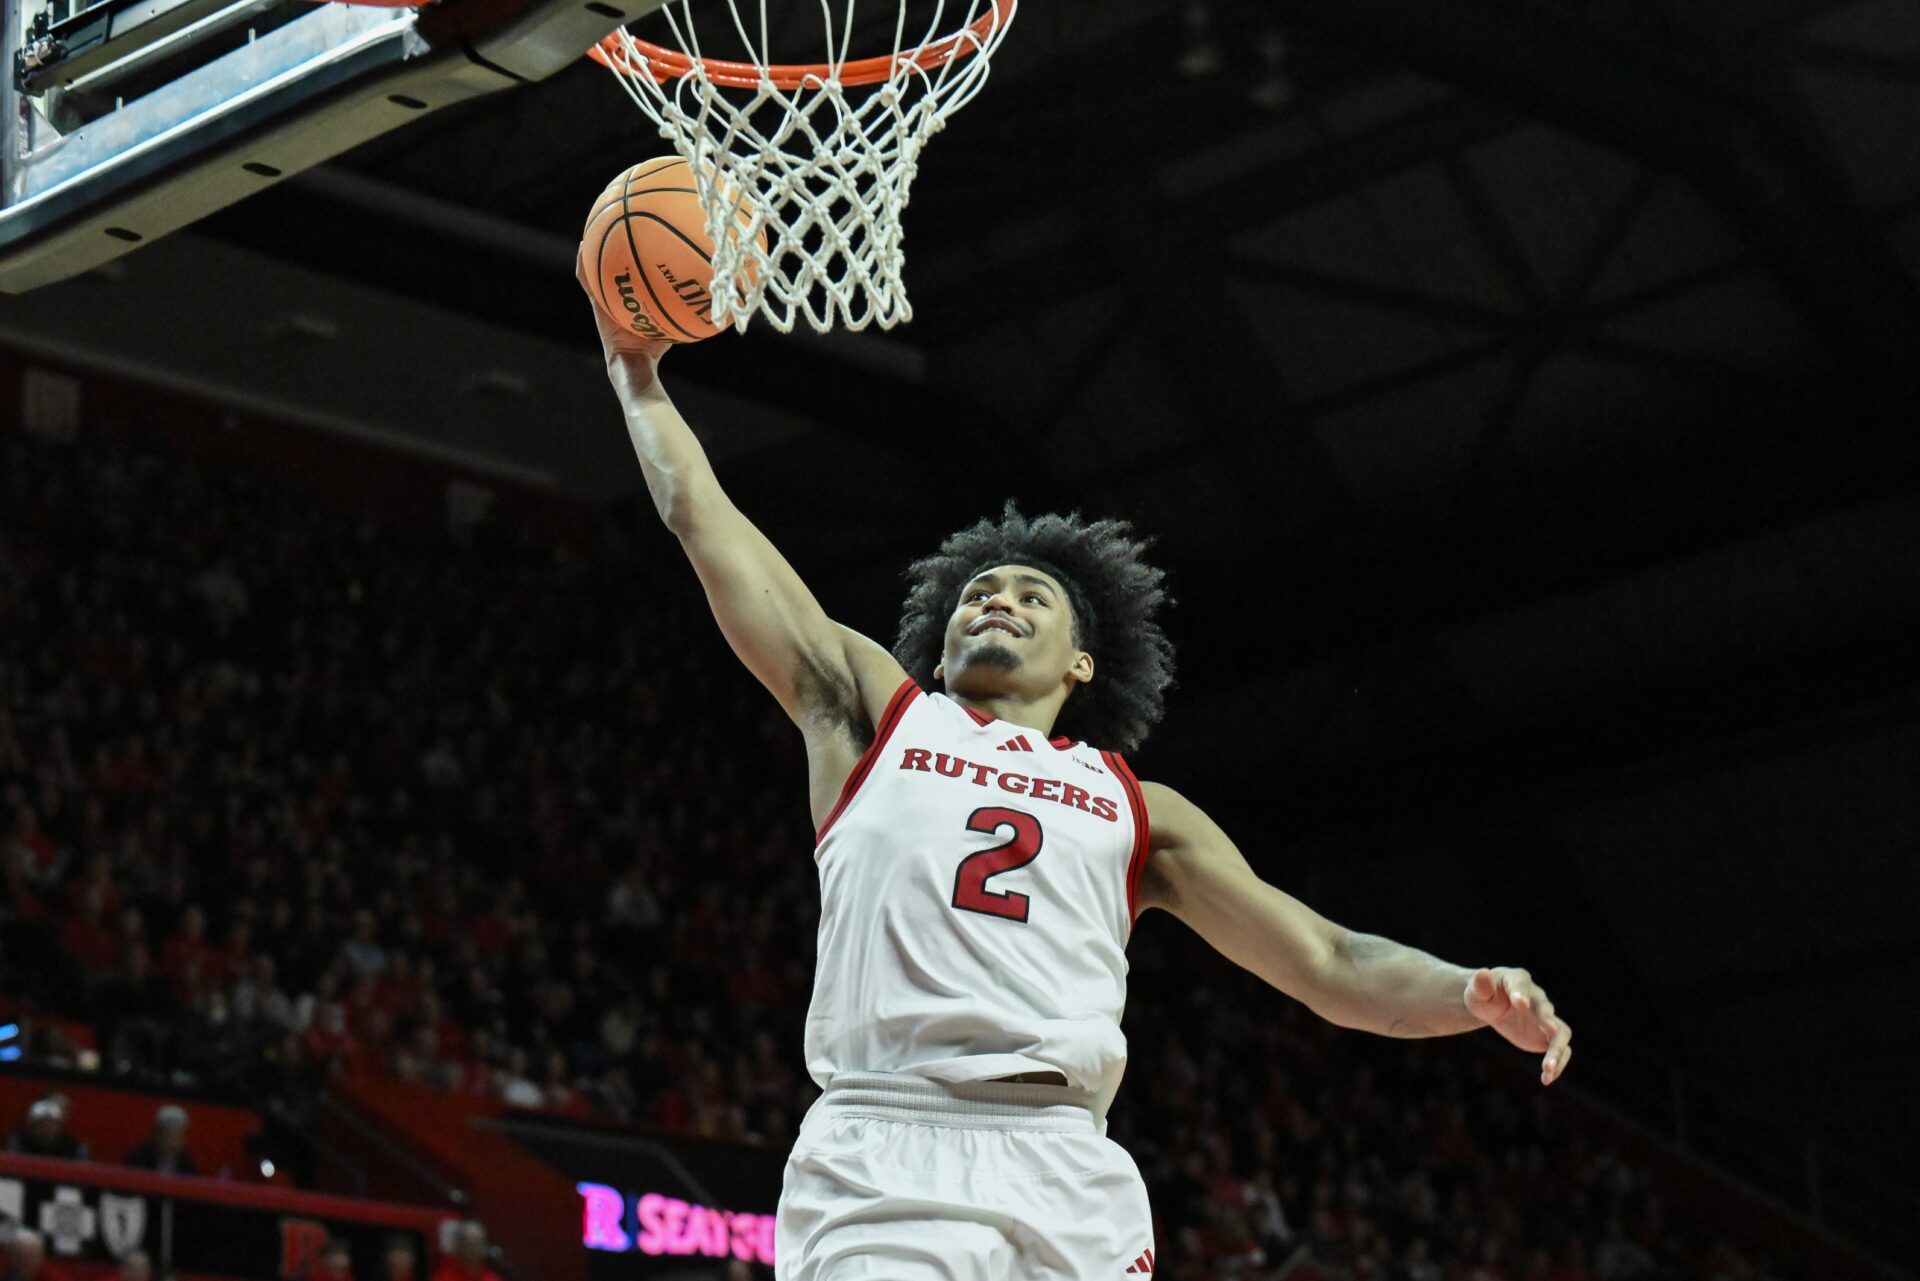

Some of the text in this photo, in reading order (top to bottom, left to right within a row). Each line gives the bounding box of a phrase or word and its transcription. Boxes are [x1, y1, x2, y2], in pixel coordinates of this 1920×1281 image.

[656, 262, 678, 284] NXT
[899, 747, 1118, 823] RUTGERS
[951, 806, 1044, 924] 2
[576, 1180, 631, 1253] R
